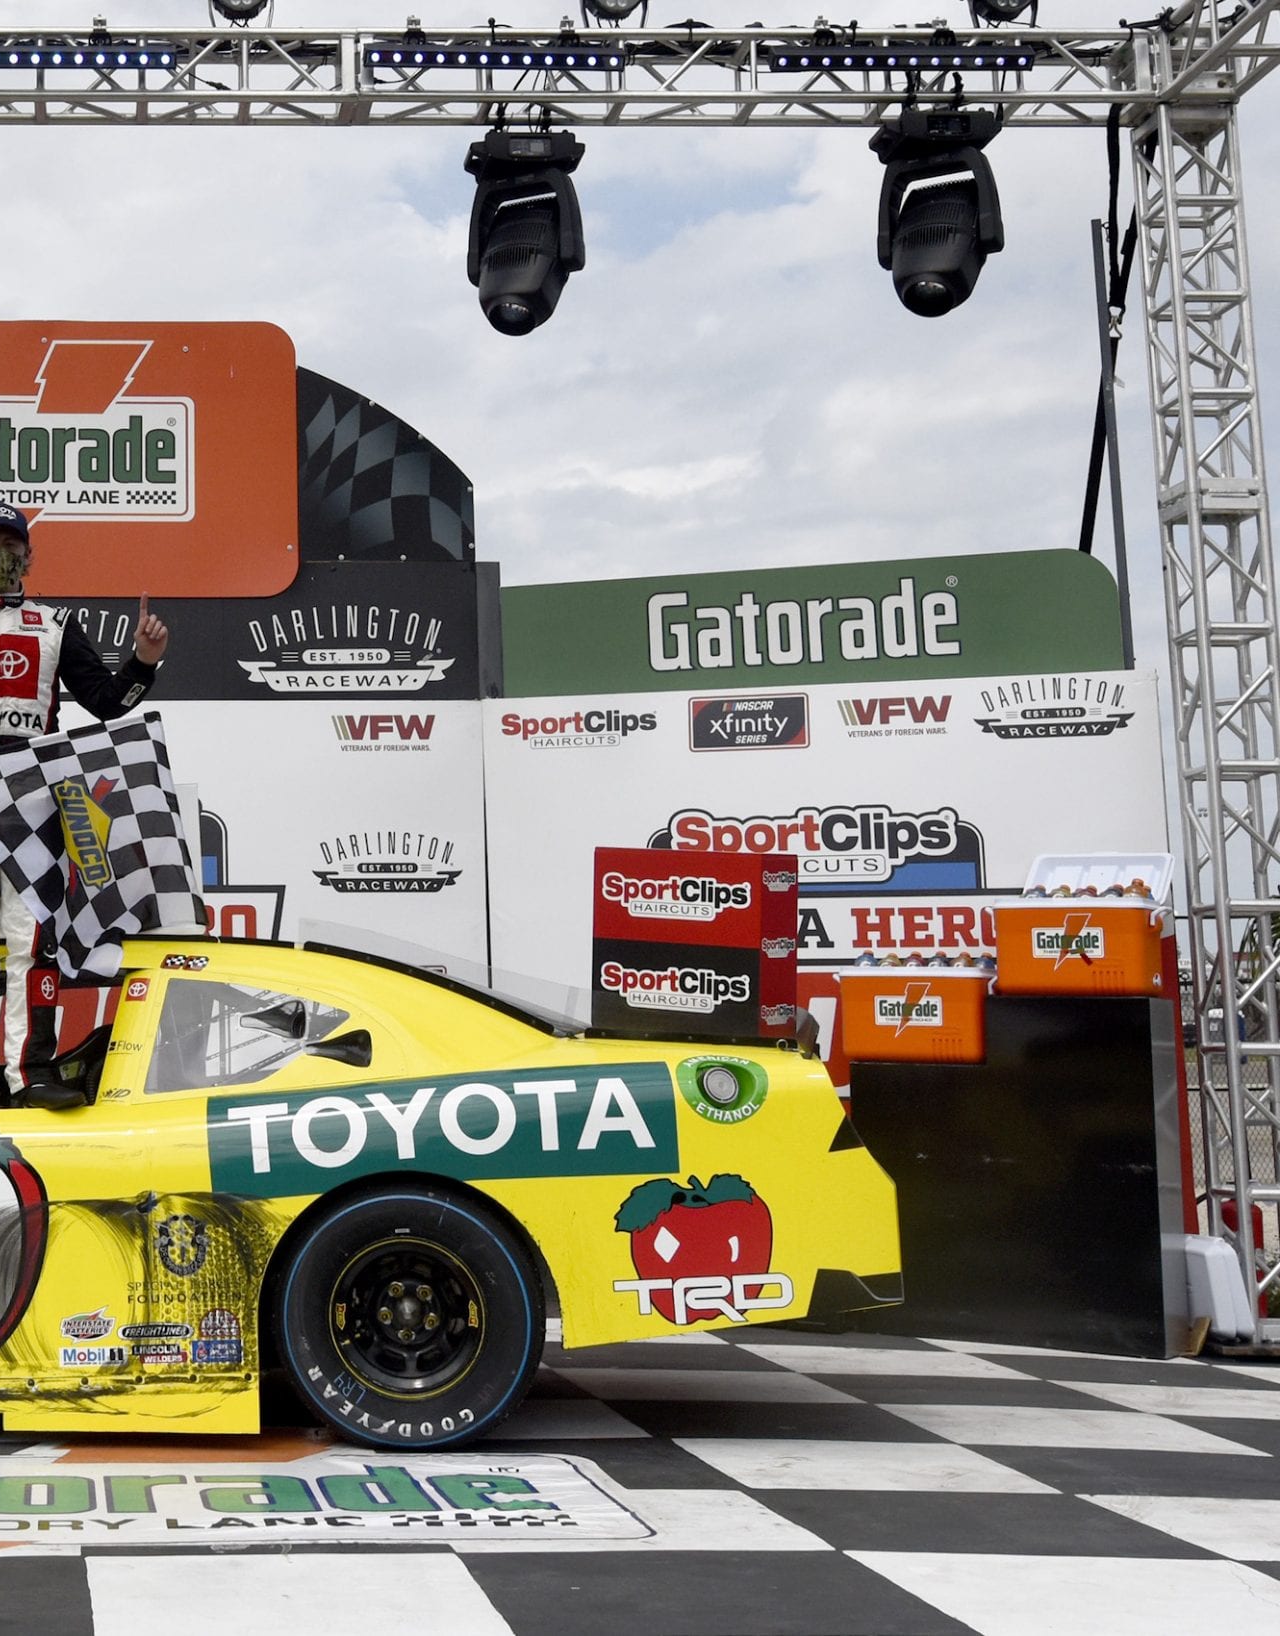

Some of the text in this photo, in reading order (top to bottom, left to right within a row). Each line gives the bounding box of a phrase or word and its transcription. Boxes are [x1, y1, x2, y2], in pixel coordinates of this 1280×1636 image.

[67, 490, 120, 504] LANE
[248, 605, 443, 652] DARLINGTON
[647, 576, 961, 672] Gatorade
[309, 652, 383, 662] EST. 1950
[287, 675, 410, 688] RACEWAY
[981, 677, 1125, 713] DARLINGTON
[734, 701, 774, 711] NASCAR
[851, 695, 952, 725] VFW
[1025, 708, 1082, 718] EST. 1950
[345, 714, 436, 741] VFW
[501, 710, 658, 740] SportClips
[710, 712, 789, 739] xfinity
[1008, 723, 1101, 737] RACEWAY
[735, 734, 768, 744] SERIES
[847, 729, 883, 738] VETERANS
[885, 729, 893, 737] OF
[894, 728, 925, 737] FOREIGN
[340, 744, 373, 752] VETERANS
[374, 744, 382, 752] OF
[383, 744, 411, 752] FOREIGN
[533, 735, 617, 748] HAIRCUTS
[56, 785, 107, 881] SUNOCO
[676, 812, 951, 858] SportClips
[320, 831, 454, 864] DARLINGTON
[361, 864, 414, 872] EST. 1950
[803, 857, 879, 873] CUTS
[763, 871, 796, 885] SportClips
[346, 881, 431, 891] RACEWAY
[605, 875, 749, 909] SportClips
[634, 902, 710, 916] HAIRCUTS
[798, 908, 835, 948] A
[762, 938, 795, 950] SportClips
[603, 964, 747, 1000] SportClips
[632, 992, 709, 1008] HAIRCUTS
[761, 1004, 794, 1018] SportClips
[116, 1041, 143, 1051] Flow
[682, 1056, 750, 1067] AMERICAN
[695, 1101, 760, 1122] ETHANOL
[227, 1077, 656, 1174] TOYOTA
[613, 1272, 795, 1326] TRD
[124, 1325, 188, 1338] FREIGHTLINER
[63, 1349, 106, 1362] Mobil
[134, 1345, 179, 1354] LINCOLN
[144, 1355, 183, 1363] WELDERS
[307, 1365, 475, 1437] GOODYEAR
[166, 1516, 368, 1531] LANE
